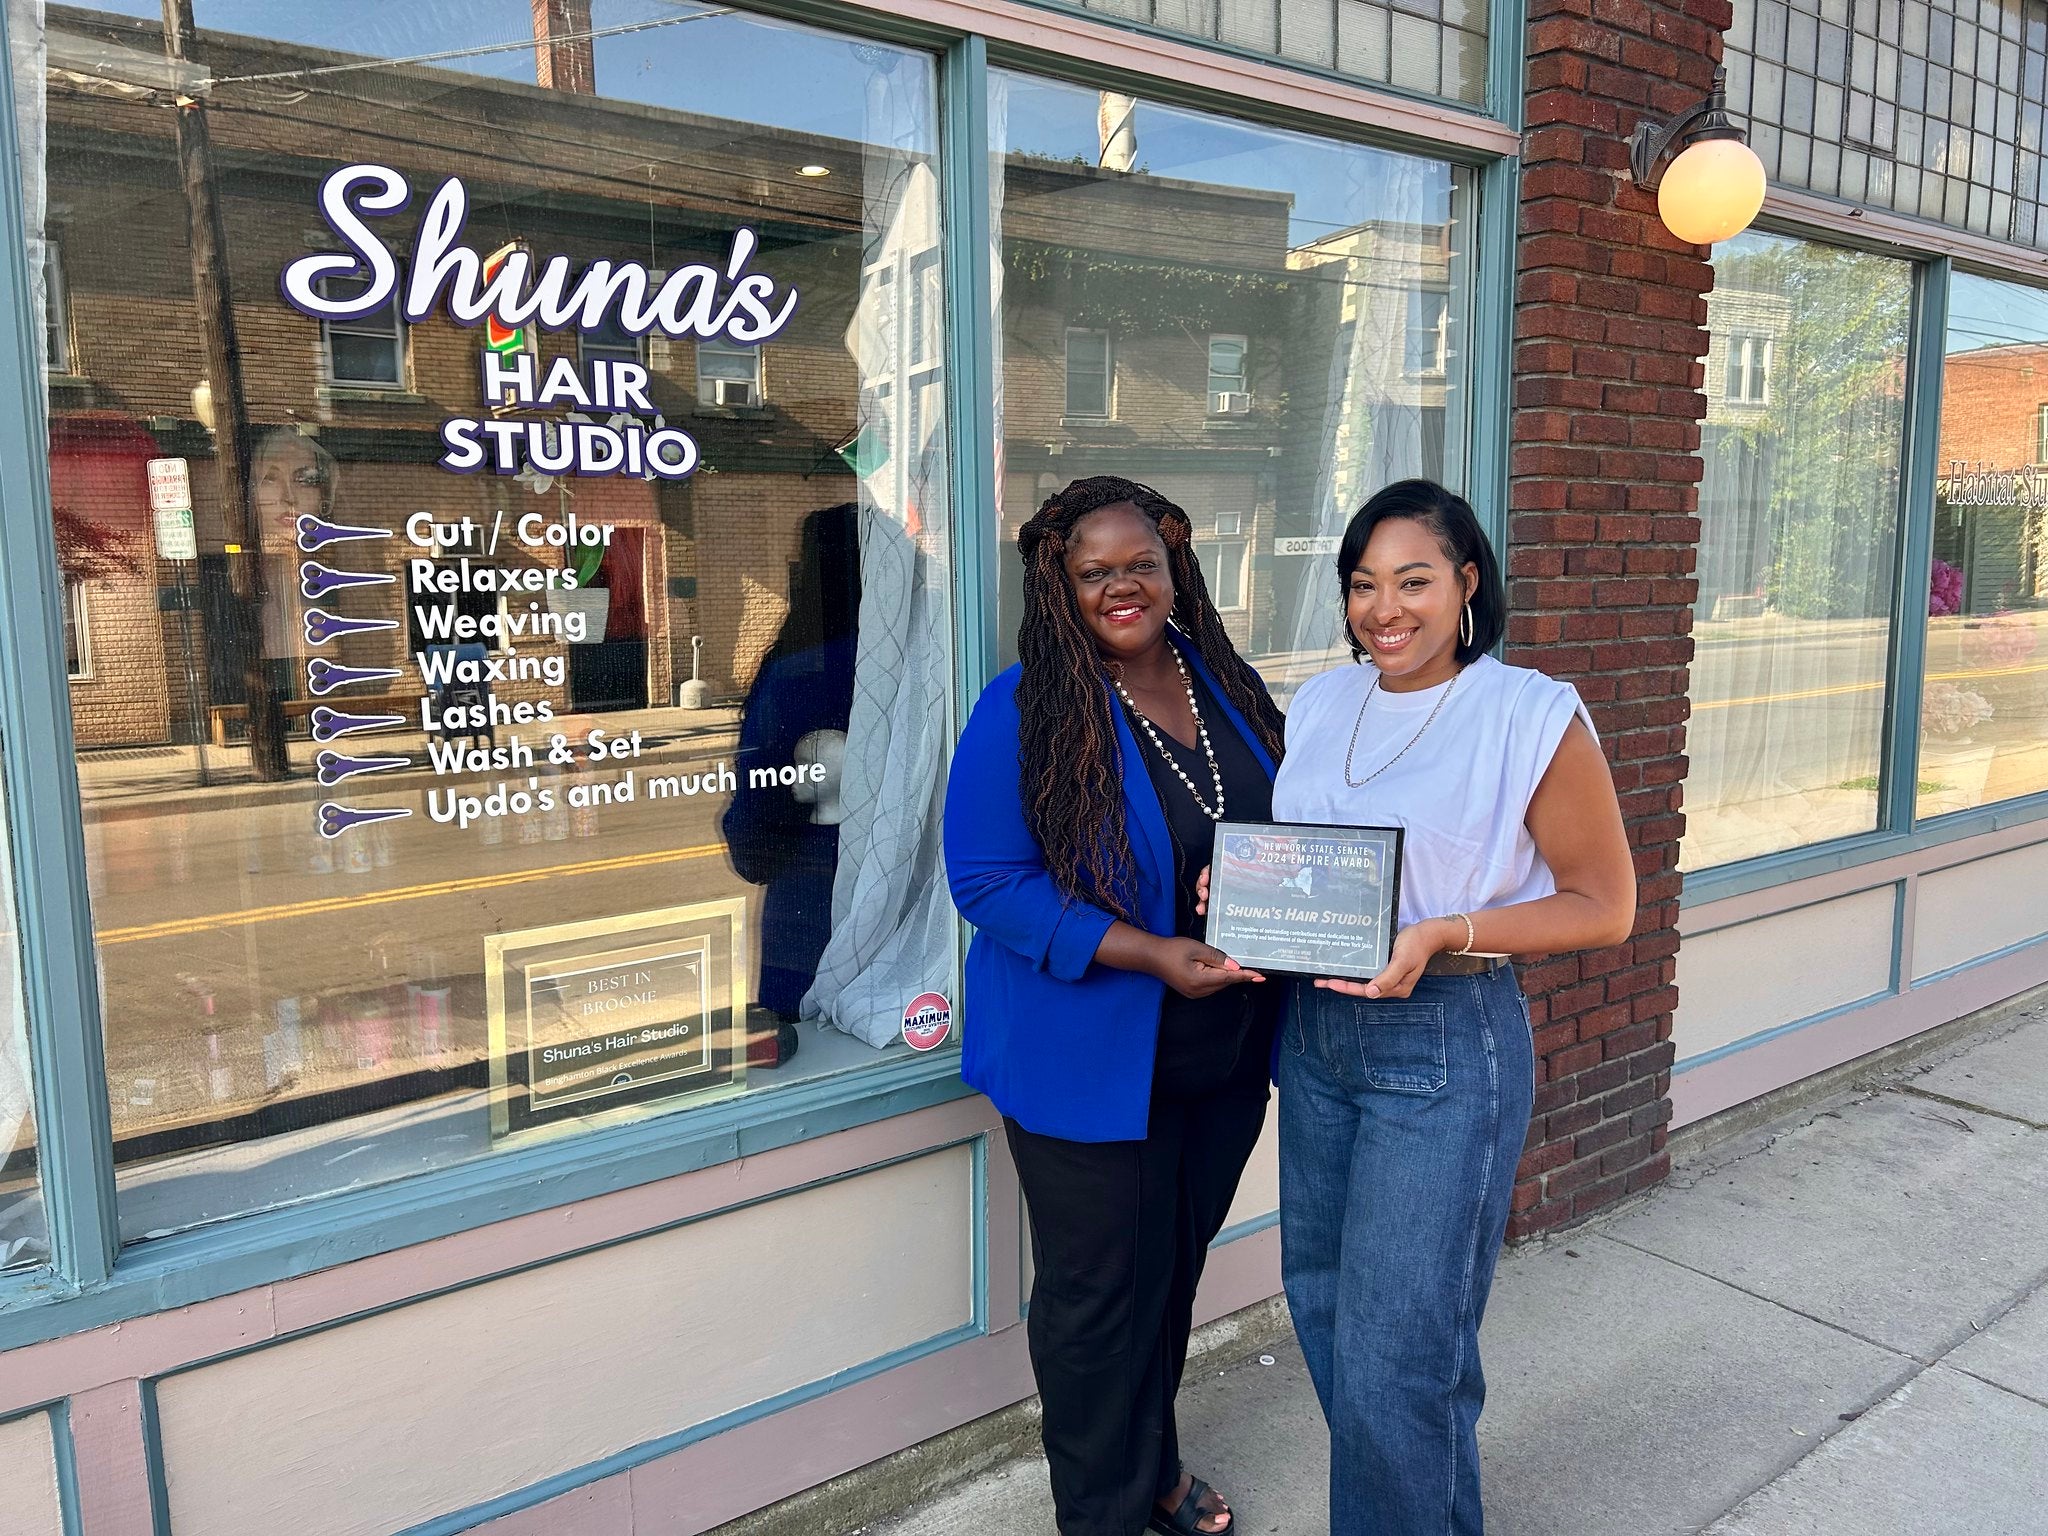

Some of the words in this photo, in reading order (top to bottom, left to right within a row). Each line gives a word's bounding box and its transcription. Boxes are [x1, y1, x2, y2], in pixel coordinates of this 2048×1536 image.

[282, 163, 798, 344] Shuna's
[482, 350, 655, 413] HAIR
[440, 417, 699, 479] STUDIO
[1947, 460, 2016, 505] Habitat
[407, 512, 473, 548] Cut
[488, 510, 503, 555] /
[518, 513, 615, 548] Color
[411, 559, 578, 594] Relaxers
[416, 603, 587, 642] Weaving
[417, 648, 566, 686] Waxing
[421, 696, 554, 731] Lashes
[428, 733, 533, 775] Wash
[548, 734, 573, 764] &
[589, 729, 643, 761] Set
[428, 781, 555, 829] Updo's
[569, 769, 634, 808] and
[649, 757, 737, 799] much
[749, 760, 826, 789] more
[1260, 853, 1287, 864] 2024
[1290, 854, 1329, 866] EMPIRE
[1333, 857, 1371, 868] AWARD
[1264, 842, 1282, 851] NEW
[1285, 843, 1307, 853] YORK
[1310, 844, 1334, 854] STATE
[1337, 845, 1368, 856] SENATE
[1225, 904, 1282, 920] SHUNA'S
[1285, 908, 1319, 923] HAIR
[1321, 911, 1373, 927] STUDIO
[588, 974, 629, 994] BEST
[635, 970, 651, 985] IN
[583, 990, 657, 1016] BROOME
[904, 1010, 950, 1028] MAXIMUM
[543, 1040, 602, 1063] Shuna's
[605, 1033, 638, 1051] Hair
[640, 1023, 689, 1043] Studio
[545, 1069, 595, 1086] Binghamton
[596, 1063, 618, 1075] Black
[619, 1055, 659, 1071] Excellence
[660, 1048, 688, 1061] Awards
